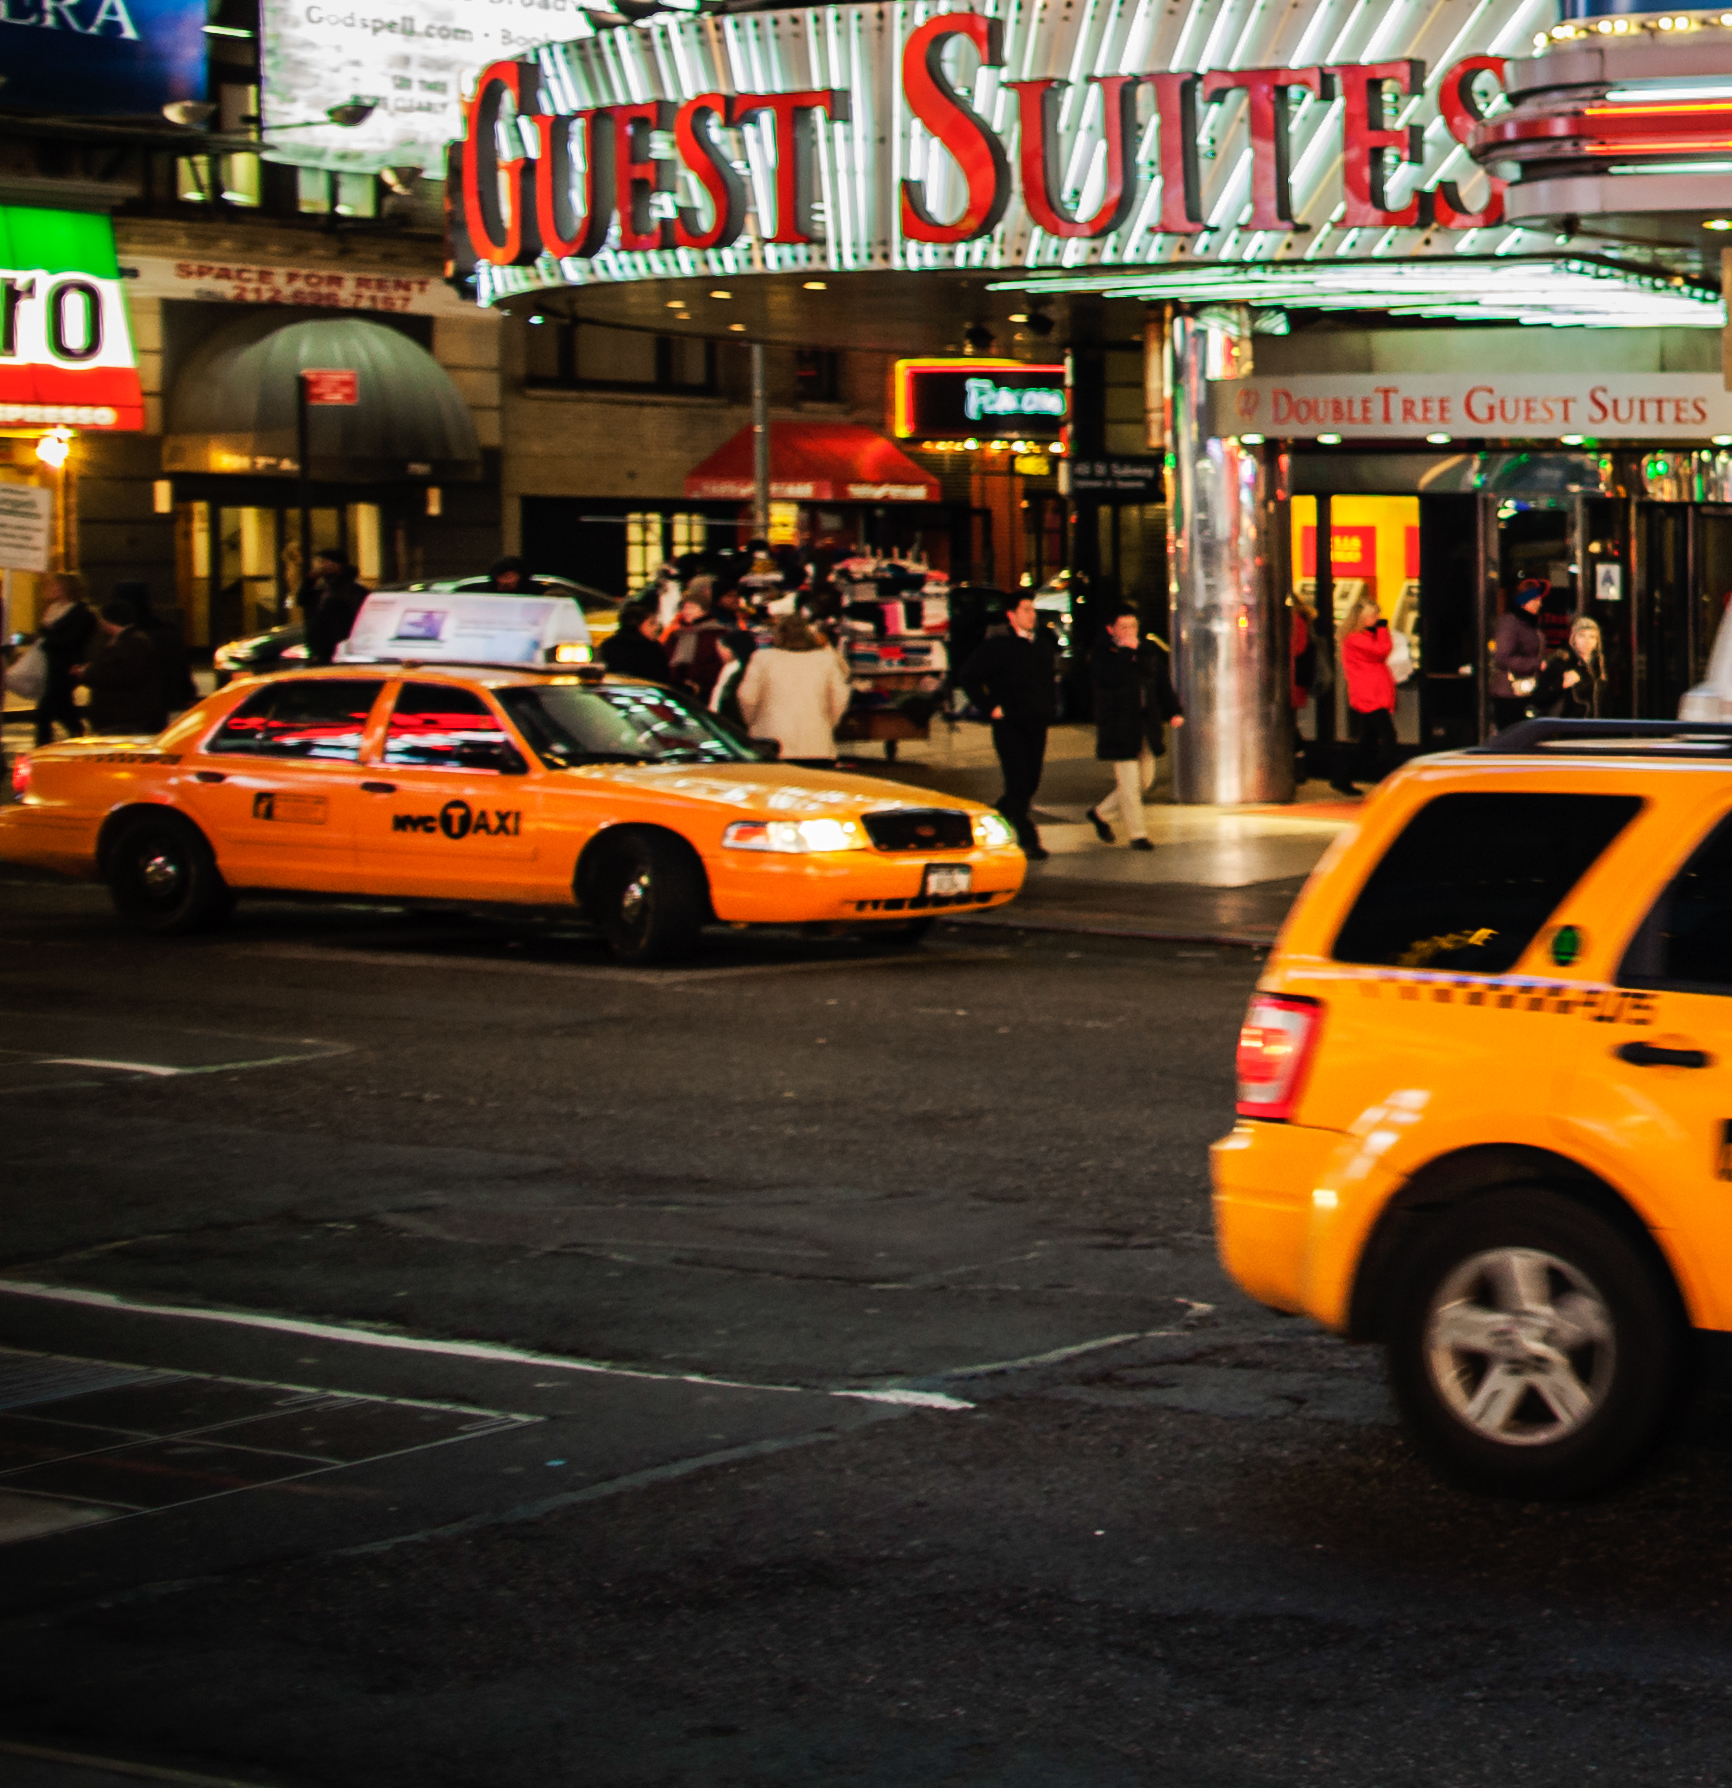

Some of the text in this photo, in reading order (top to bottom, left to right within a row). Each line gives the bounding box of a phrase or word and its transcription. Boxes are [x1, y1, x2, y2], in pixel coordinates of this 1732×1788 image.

[305, 5, 474, 42] Godspell.com
[462, 12, 1508, 267] GUEST SUITES
[175, 263, 431, 295] SPACE FOR RENT
[1463, 384, 1575, 427] GUEST
[1588, 384, 1709, 427] SUITES
